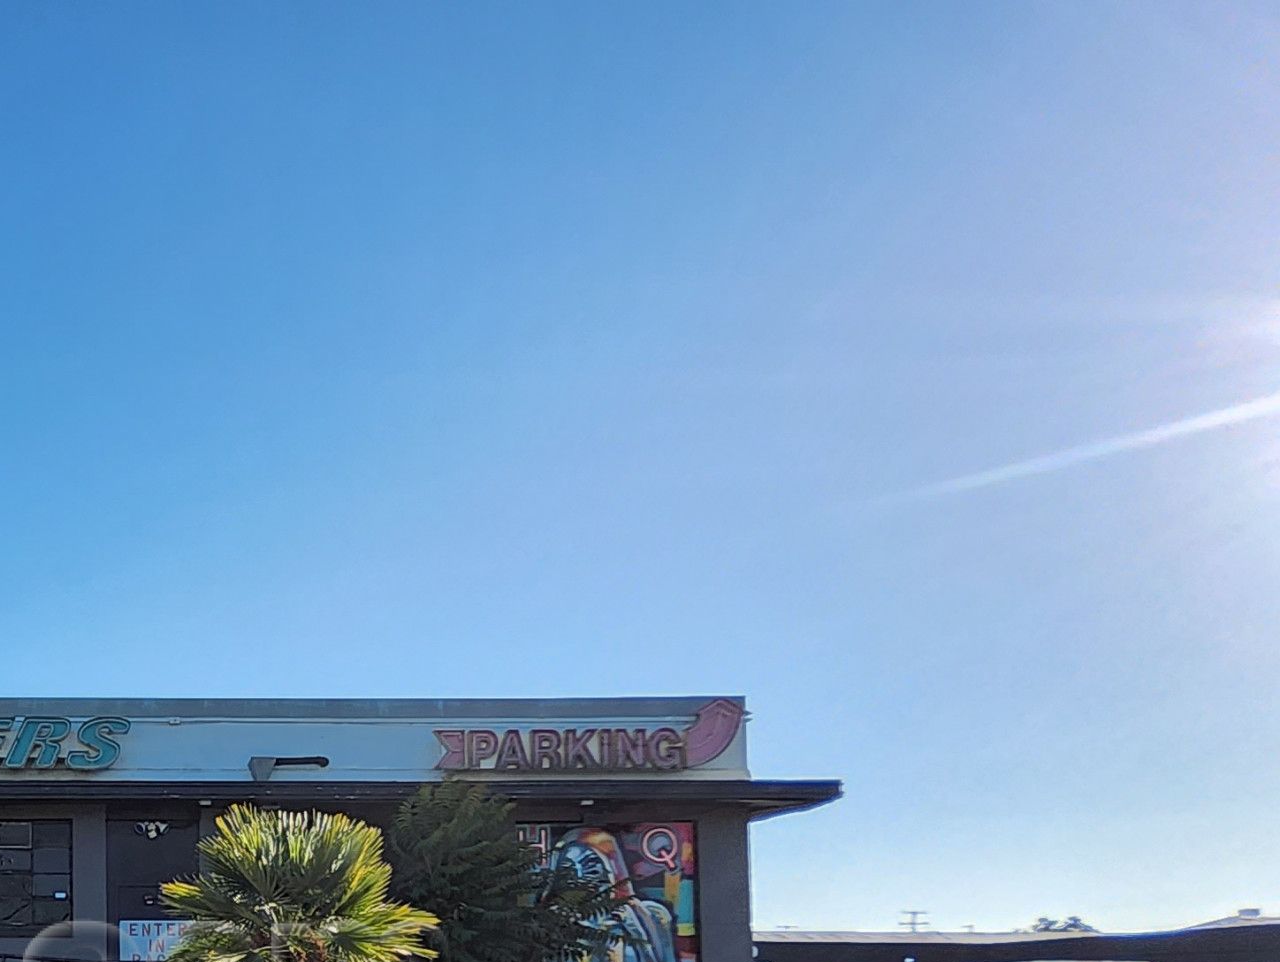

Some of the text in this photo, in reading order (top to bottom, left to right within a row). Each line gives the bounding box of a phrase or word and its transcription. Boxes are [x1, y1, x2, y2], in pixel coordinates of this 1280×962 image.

[469, 727, 686, 770] PARKING
[129, 922, 187, 937] ENTER
[148, 939, 165, 953] IN
